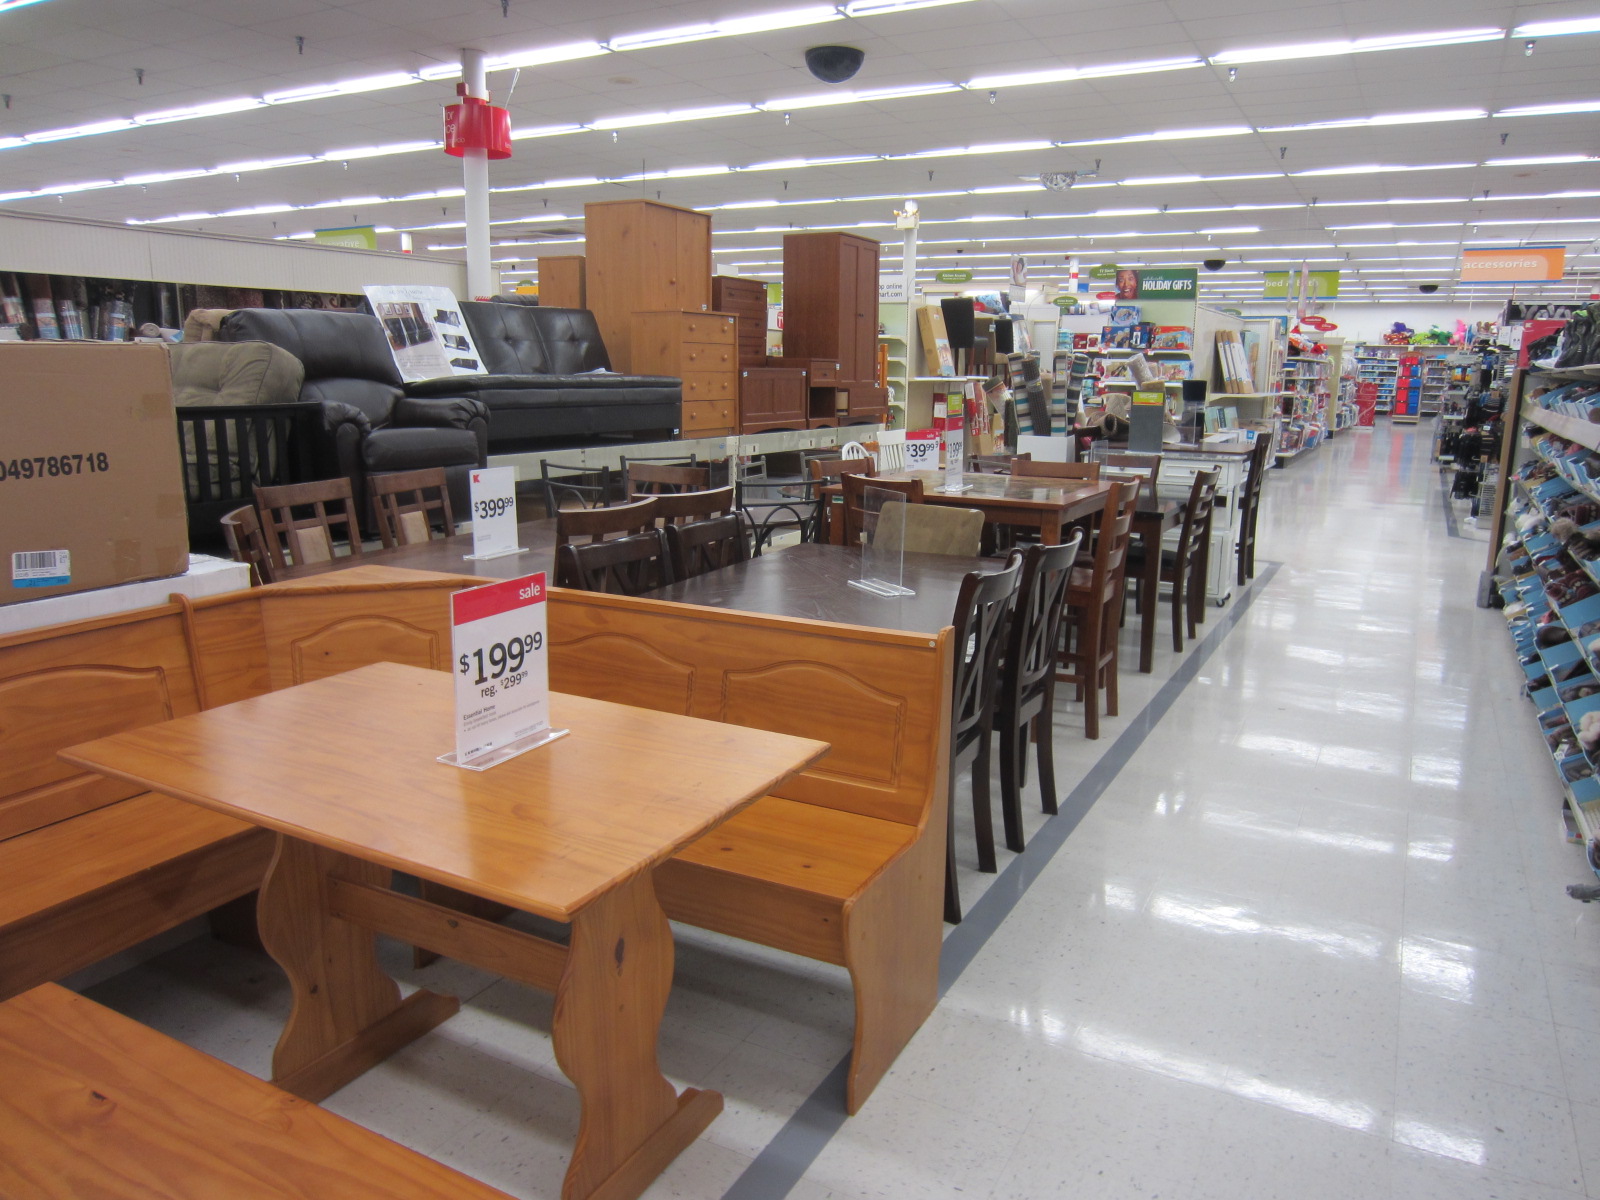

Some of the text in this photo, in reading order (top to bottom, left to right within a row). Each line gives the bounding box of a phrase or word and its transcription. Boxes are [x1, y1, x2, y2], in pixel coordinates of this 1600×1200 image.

[1463, 259, 1538, 269] accessories
[886, 282, 903, 290] online
[1142, 279, 1192, 291] HOLIDAY GIFTS
[519, 582, 541, 600] sale
[480, 685, 498, 698] reg.
[463, 708, 483, 721] Essential
[483, 704, 496, 714] Home
